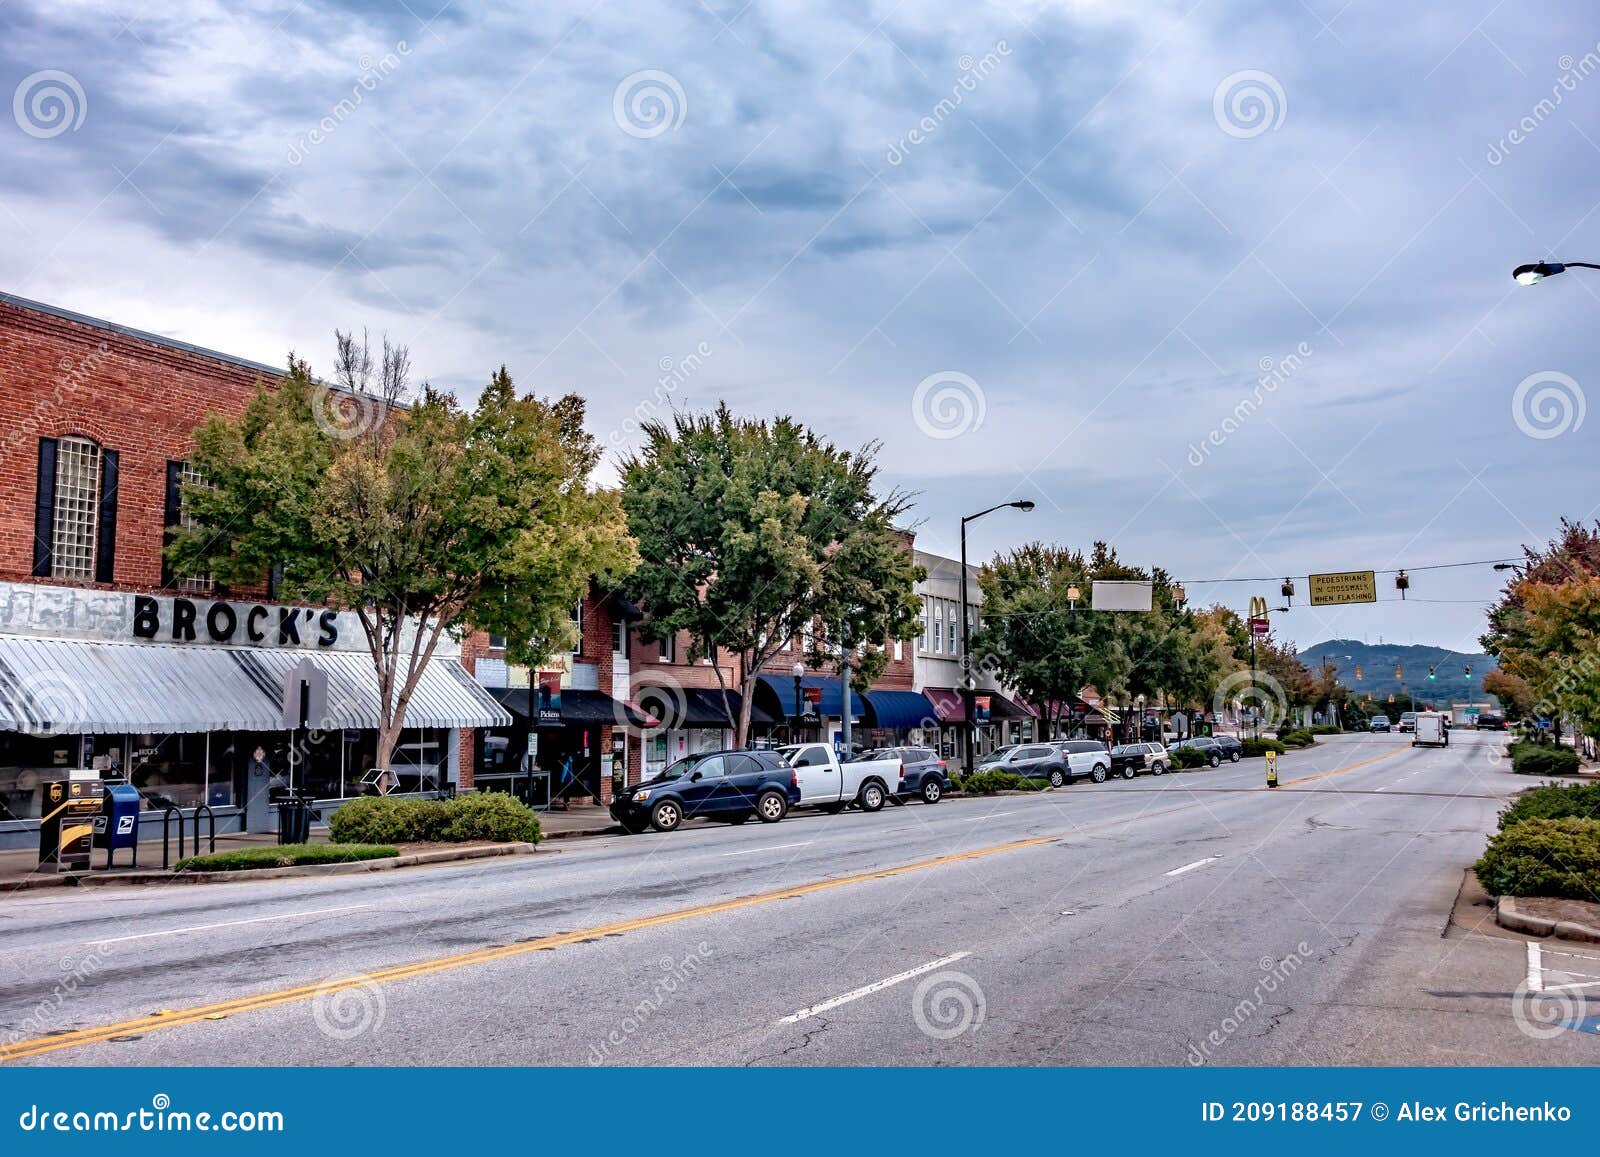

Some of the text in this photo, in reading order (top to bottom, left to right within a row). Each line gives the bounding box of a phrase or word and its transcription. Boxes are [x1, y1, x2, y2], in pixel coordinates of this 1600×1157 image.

[1316, 574, 1367, 584] PEDESTRIANS
[1327, 584, 1369, 593] CROSSWALK
[1314, 593, 1372, 603] WHEN FLASHING
[133, 595, 338, 646] BROCK'S
[540, 710, 560, 718] Pickens
